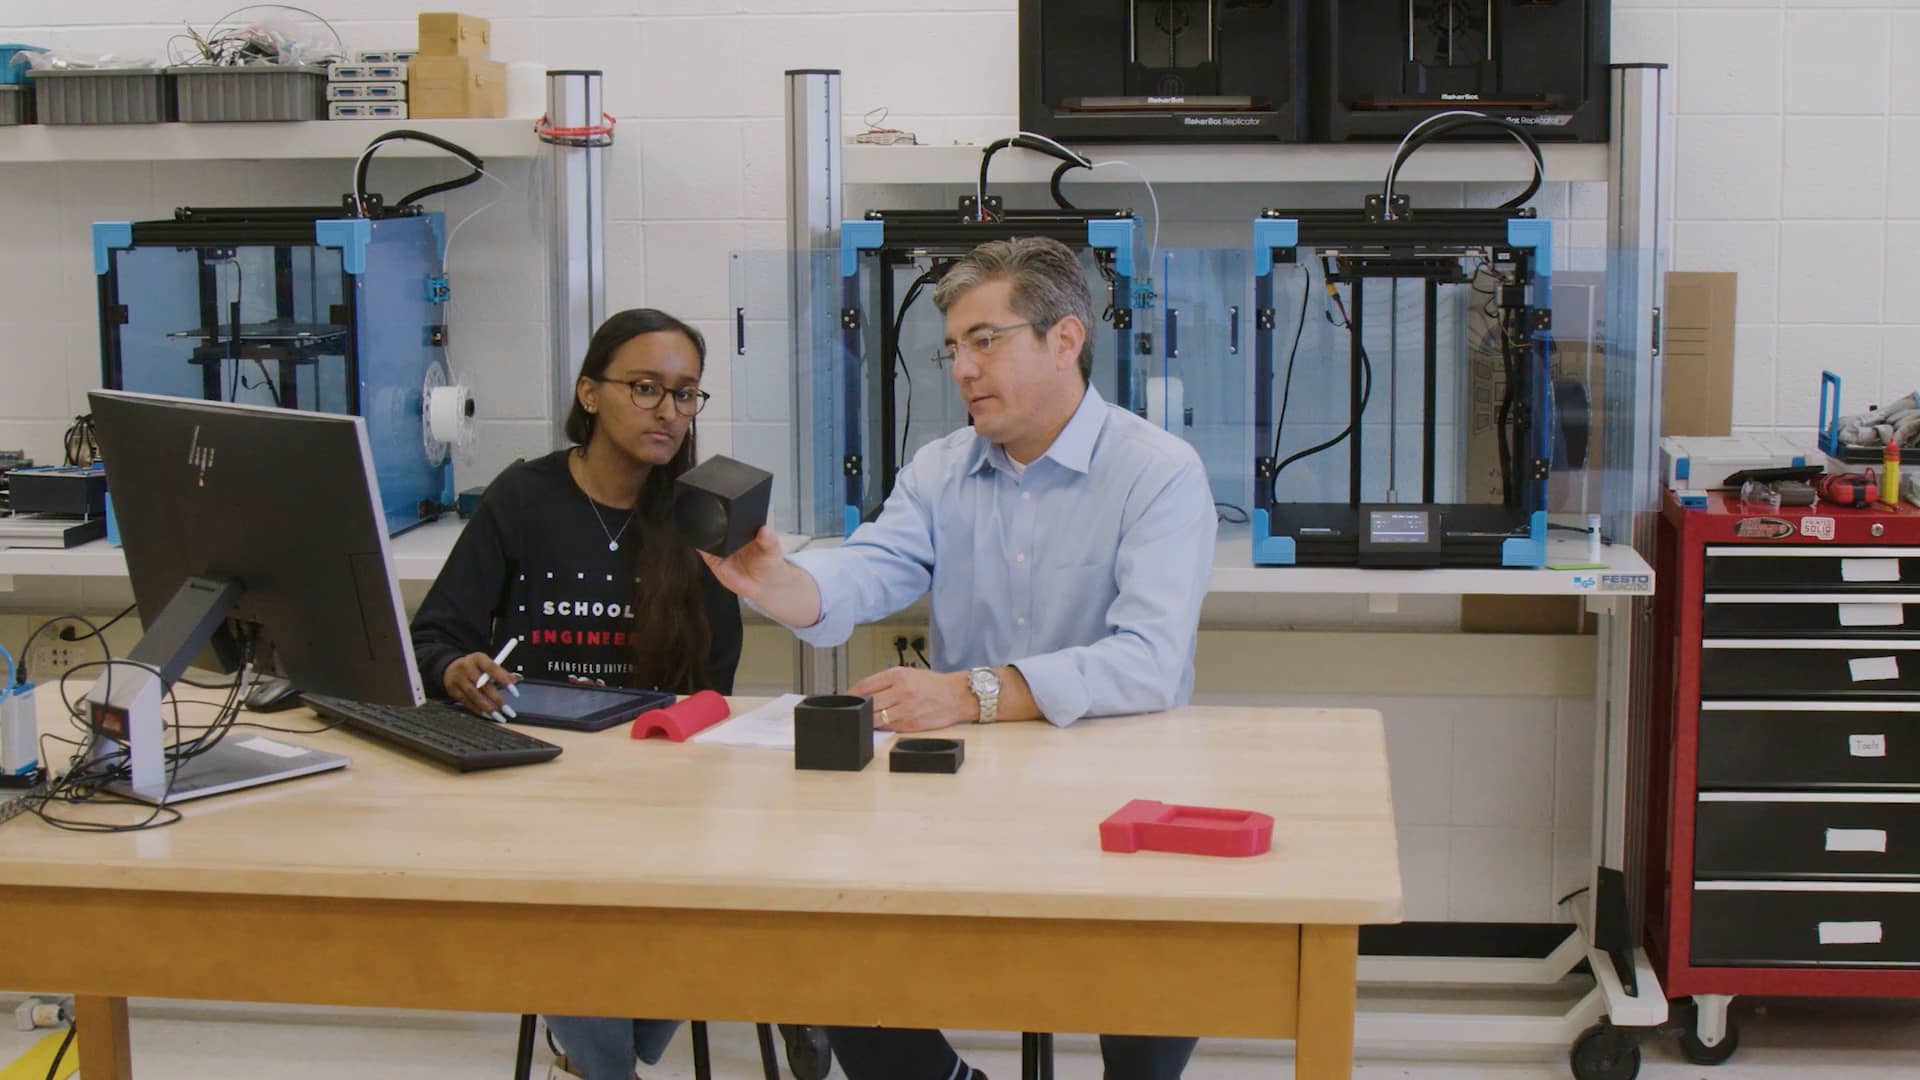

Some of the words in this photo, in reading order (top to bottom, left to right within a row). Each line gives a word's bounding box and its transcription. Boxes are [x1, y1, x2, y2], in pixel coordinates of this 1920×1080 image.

[1183, 117, 1222, 125] MakerBot
[1222, 117, 1260, 126] Replicator
[1602, 575, 1648, 583] FESTO
[543, 601, 635, 618] SCHOOL
[548, 661, 601, 674] FAIRFIELD
